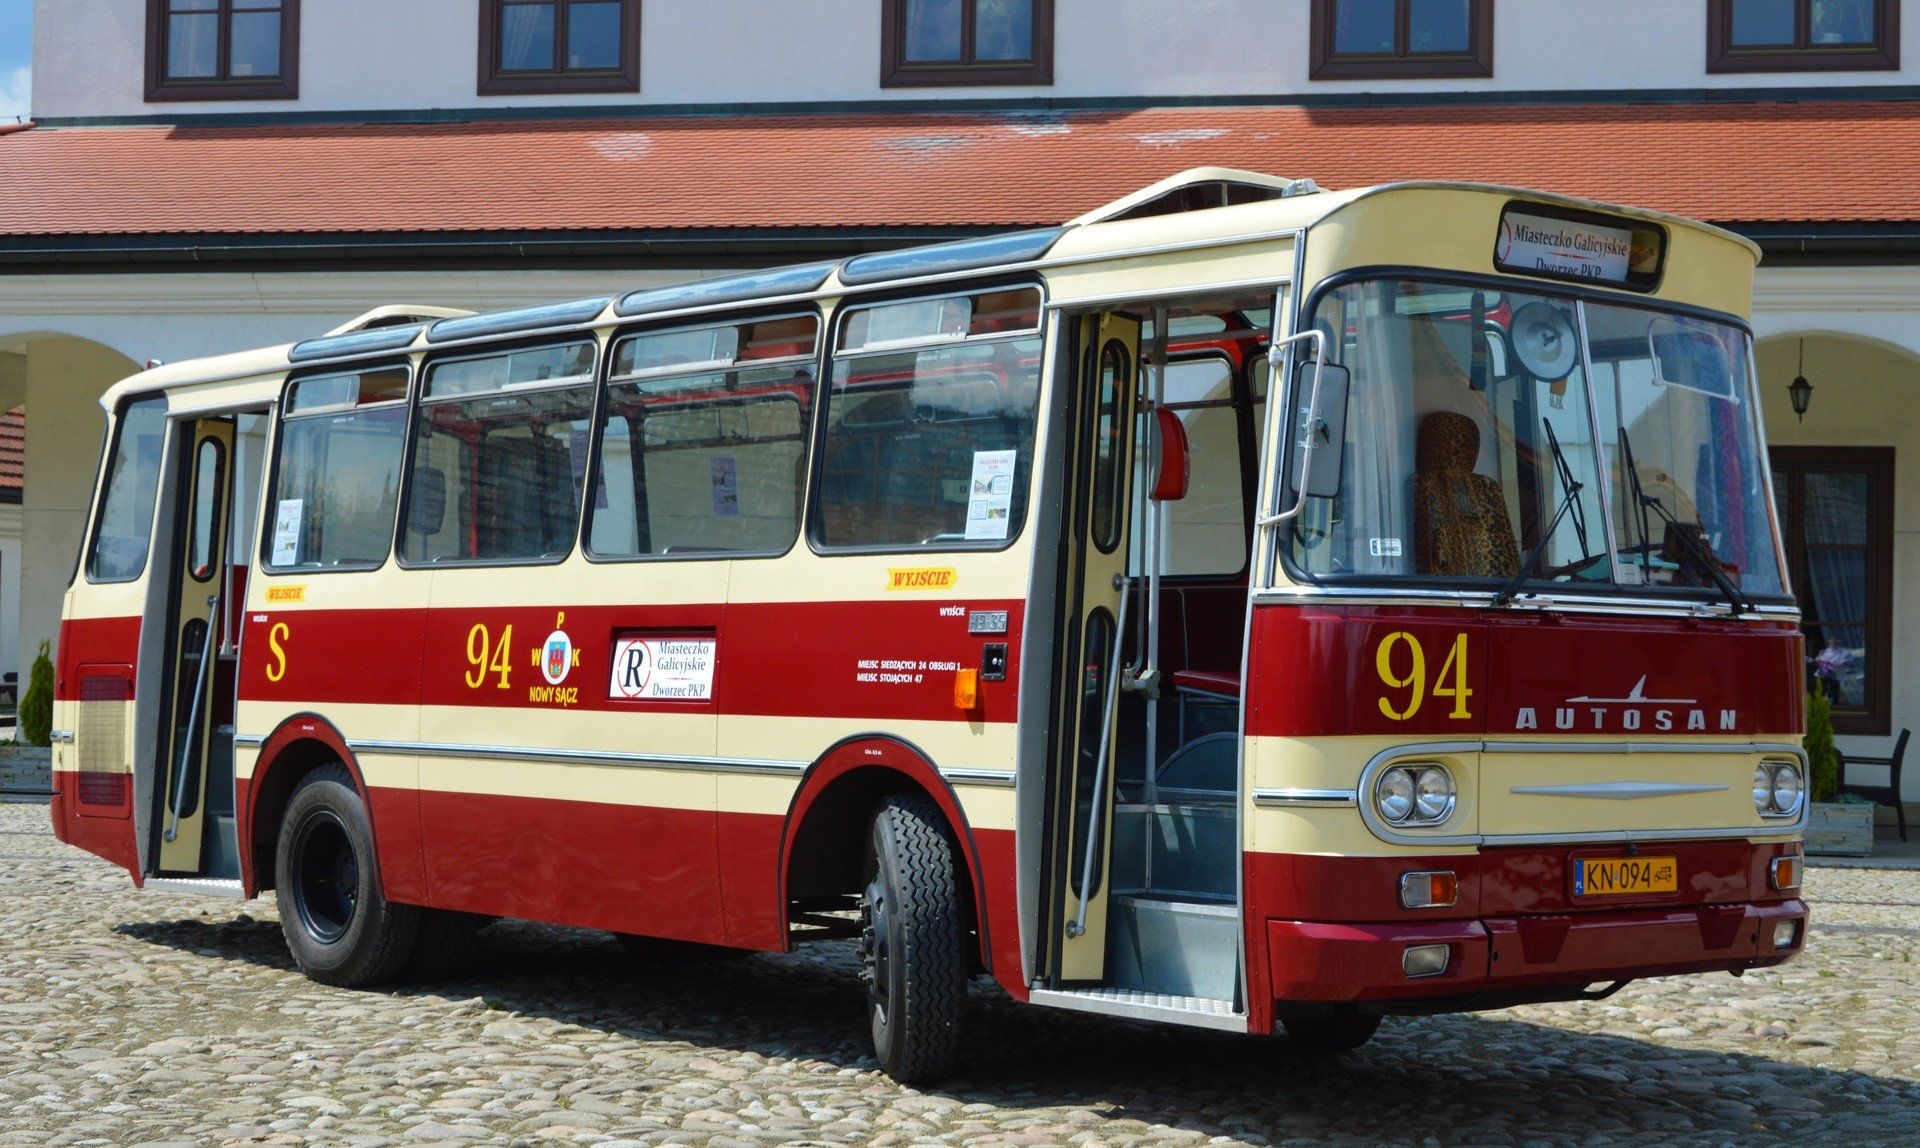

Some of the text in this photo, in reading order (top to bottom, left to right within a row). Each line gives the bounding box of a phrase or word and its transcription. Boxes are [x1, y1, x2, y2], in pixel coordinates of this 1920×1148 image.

[1514, 224, 1627, 258] Miasteczko Galicyjskie
[1580, 265, 1602, 278] PKP
[894, 570, 950, 586] WYJŚCIE
[940, 605, 965, 616] WYJŚCIE
[556, 611, 565, 629] P
[266, 622, 289, 682] S
[465, 623, 512, 689] 94
[658, 641, 709, 655] Miasteczko
[531, 648, 581, 667] W K
[657, 657, 706, 674] Galicyjskie
[857, 660, 879, 669] MIEJSC
[880, 660, 917, 671] SIEDZĄCYCH
[918, 661, 927, 670] 24
[623, 648, 644, 688] R
[1376, 631, 1473, 721] 94
[857, 673, 878, 682] MIEJSC
[914, 674, 923, 683] 47
[529, 686, 578, 707] NOWY SĄCZ
[652, 683, 705, 697] Dworzec PKP
[1515, 707, 1736, 731] AUTOSAN
[1587, 861, 1651, 891] KN 094
